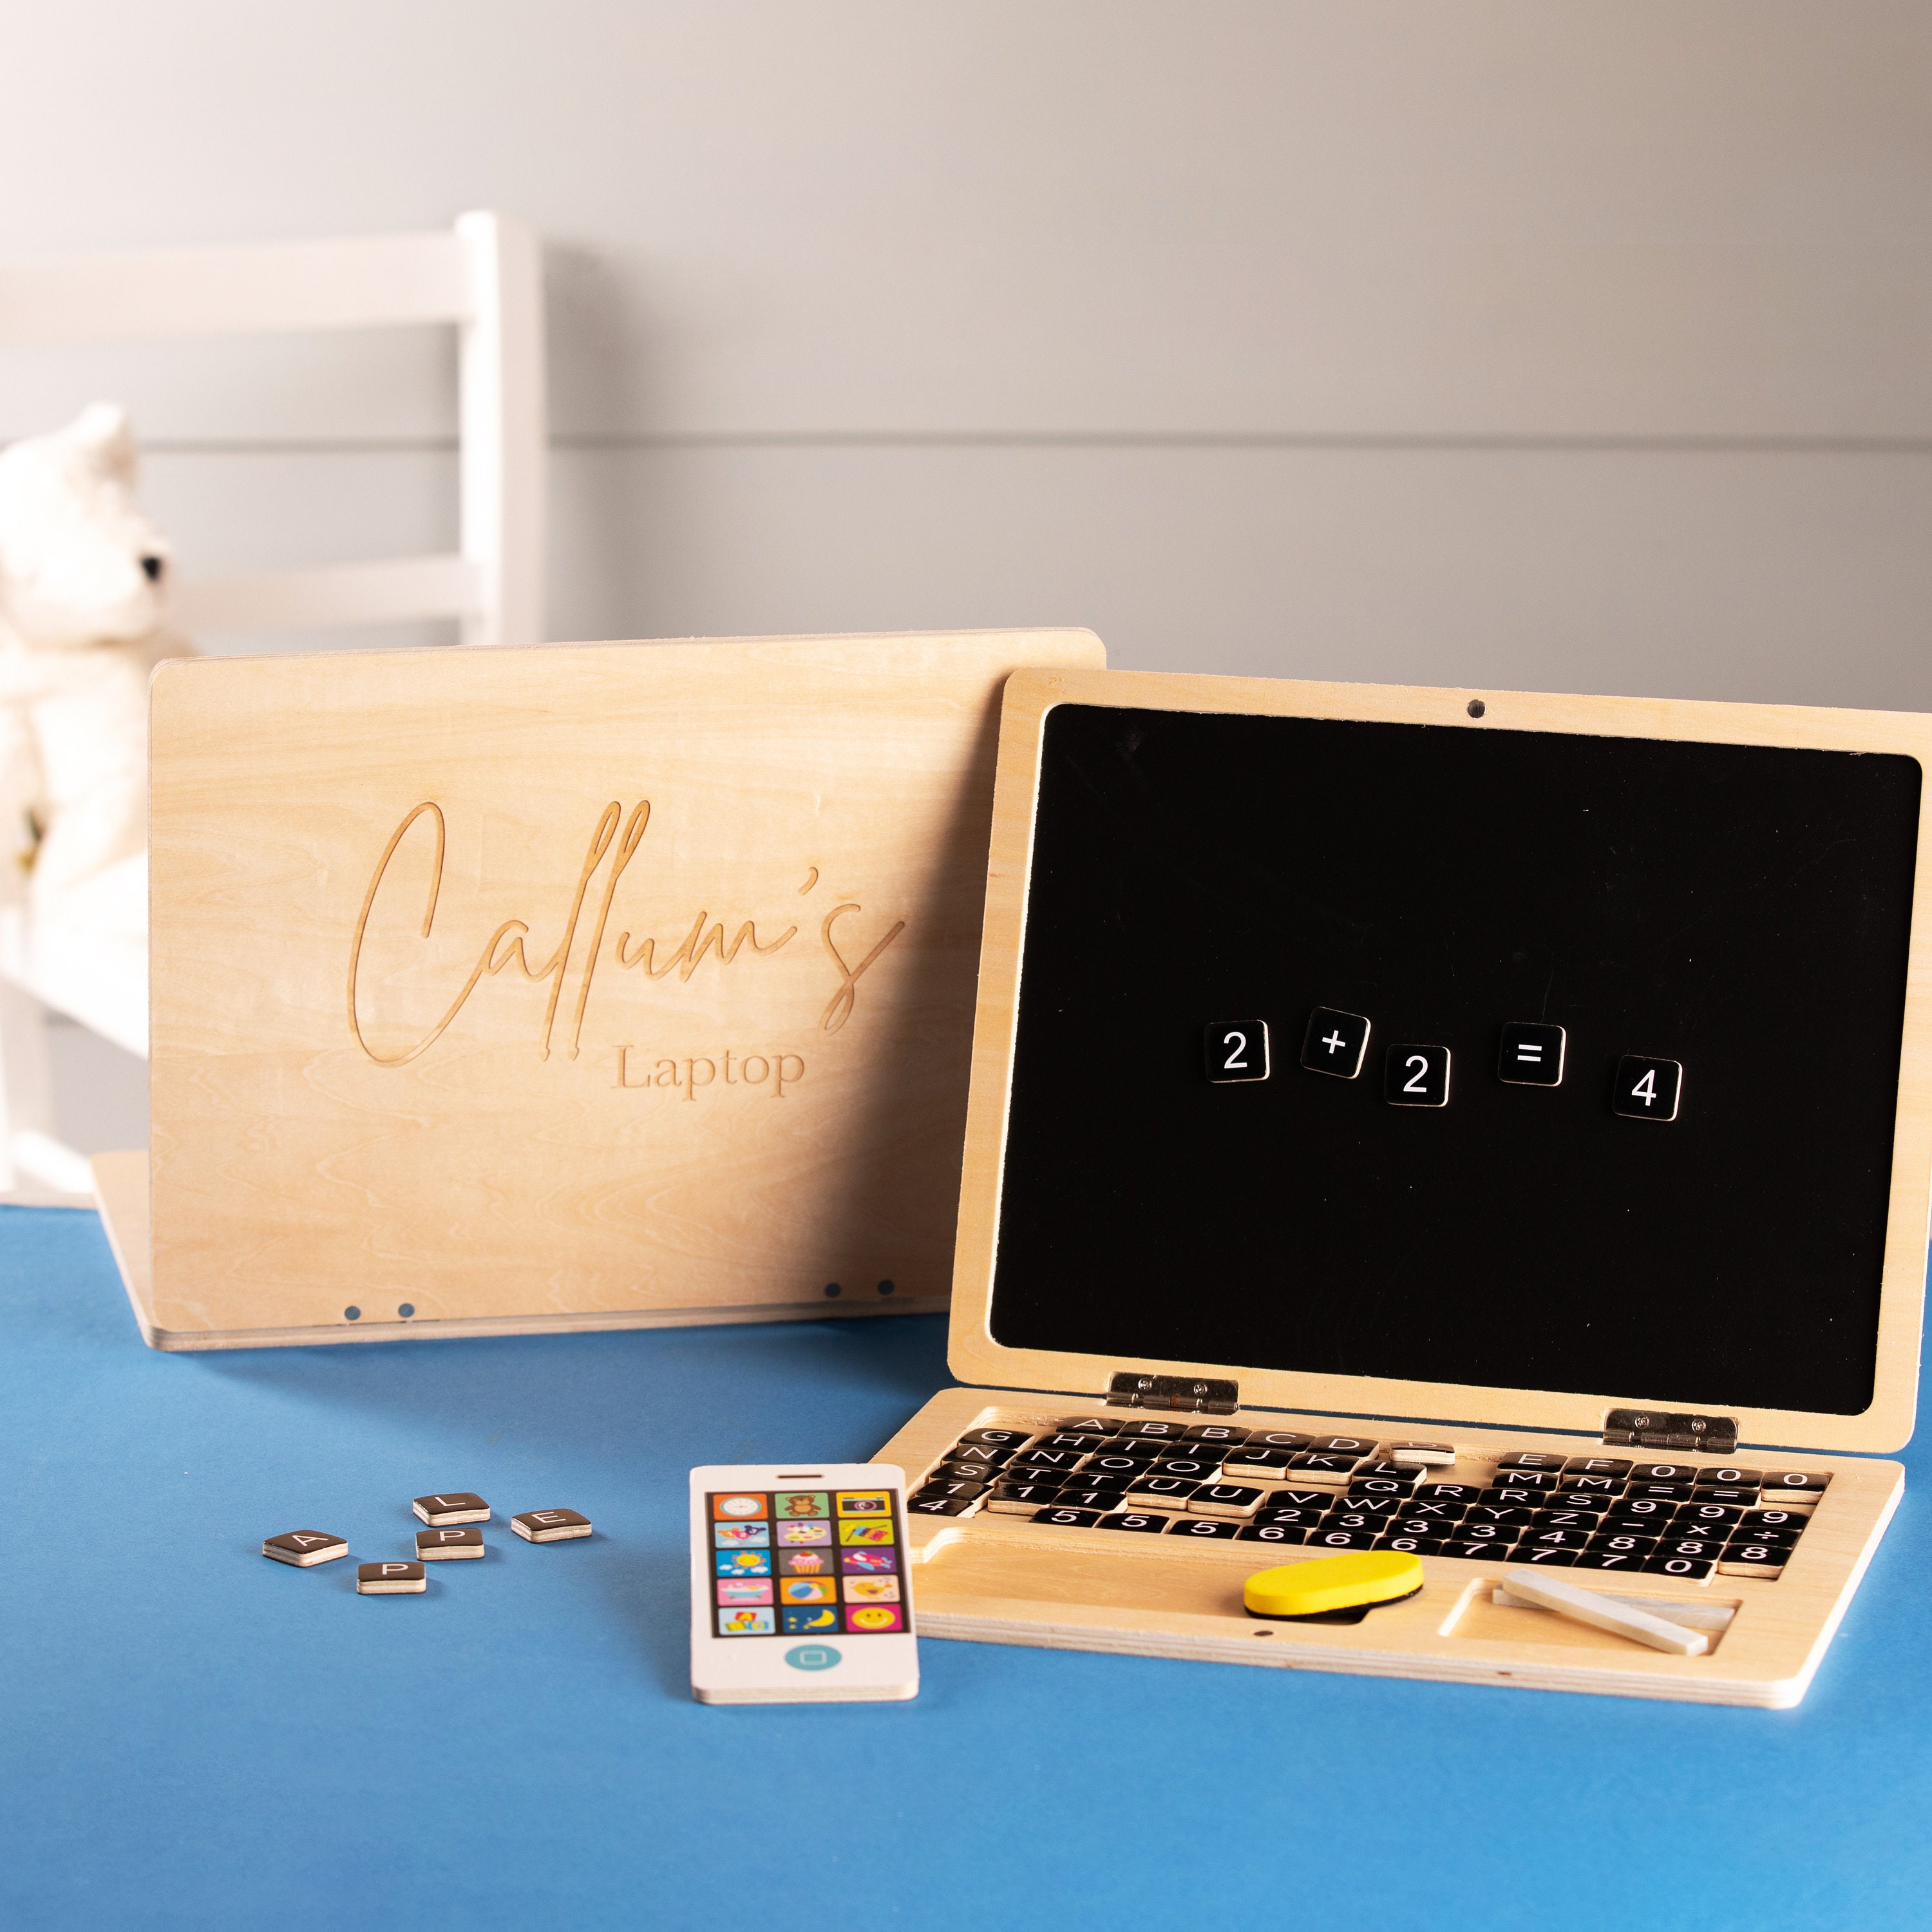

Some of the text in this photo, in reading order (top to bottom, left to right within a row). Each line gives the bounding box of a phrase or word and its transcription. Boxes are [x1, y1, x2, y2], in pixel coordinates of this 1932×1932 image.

[346, 799, 905, 1069] Callum's
[611, 1045, 804, 1101] Laptop
[1224, 1032, 1247, 1068] 2
[1403, 1056, 1428, 1092] 2
[1632, 1070, 1656, 1106] 4
[981, 1431, 1012, 1441] G
[1053, 1435, 1085, 1445] H
[1125, 1441, 1136, 1450] I
[1189, 1444, 1199, 1454] I
[1245, 1450, 1270, 1459] J
[1307, 1455, 1338, 1466] K
[1375, 1462, 1396, 1473] L
[1509, 1473, 1542, 1484] M
[1577, 1477, 1612, 1488] M
[1074, 1419, 1103, 1429] A
[1141, 1423, 1168, 1434] B
[1202, 1428, 1229, 1438] B
[1266, 1434, 1296, 1443] C
[1329, 1439, 1359, 1448] D
[1519, 1454, 1546, 1464] E
[1586, 1459, 1613, 1469] F
[435, 1497, 465, 1506] L
[955, 1465, 985, 1475] S
[1027, 1468, 1051, 1479] T
[1089, 1475, 1113, 1484] T
[1149, 1479, 1180, 1490] U
[1211, 1486, 1242, 1497] U
[1288, 1492, 1318, 1502] V
[1344, 1499, 1390, 1509] W
[1416, 1503, 1446, 1514] X
[1485, 1508, 1514, 1519] Y
[1550, 1513, 1578, 1524] Z
[963, 1447, 998, 1459] N
[1030, 1451, 1064, 1462] N
[1365, 1481, 1398, 1492] Q
[1434, 1485, 1463, 1497] R
[1500, 1490, 1528, 1501] R
[1567, 1495, 1591, 1504] S
[1631, 1501, 1656, 1512] 9
[1699, 1506, 1724, 1517] 9
[1762, 1511, 1788, 1522] 9
[292, 1535, 328, 1546] A
[440, 1531, 465, 1541] P
[531, 1512, 565, 1523] E
[919, 1501, 947, 1510] 4
[1051, 1511, 1077, 1522] 5
[1122, 1515, 1149, 1526] 5
[1191, 1522, 1218, 1533] 5
[1260, 1528, 1284, 1539] 6
[1325, 1533, 1351, 1544] 6
[1392, 1539, 1417, 1550] 6
[1463, 1542, 1488, 1554] 7
[1531, 1549, 1557, 1560] 7
[1602, 1555, 1627, 1566] 7
[947, 1483, 1768, 1558] 1 1 1 2 3 3 3 4 8 8 8
[383, 1564, 408, 1575] P
